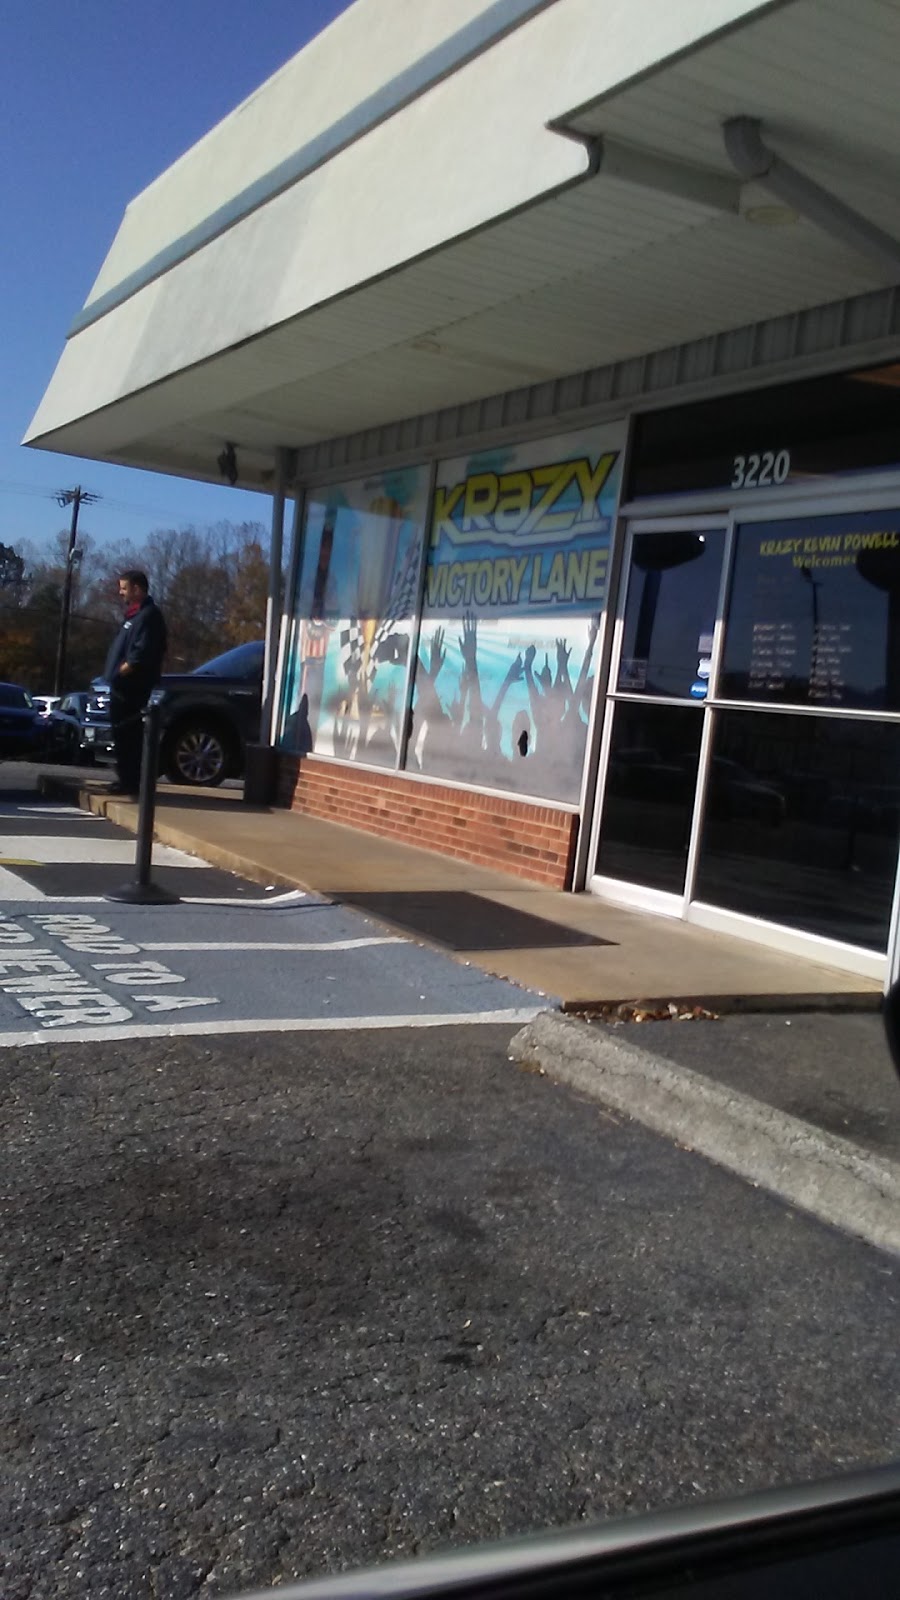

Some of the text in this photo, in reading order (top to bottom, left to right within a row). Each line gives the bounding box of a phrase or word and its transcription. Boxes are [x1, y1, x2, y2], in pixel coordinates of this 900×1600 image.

[731, 450, 790, 489] 3220
[760, 532, 899, 556] KRAZY KEVIN POWELL
[425, 549, 609, 607] VICTORY LANE
[27, 914, 140, 955] ROAD
[0, 949, 134, 1028] NEWER
[91, 961, 187, 985] TO
[132, 995, 221, 1012] A
